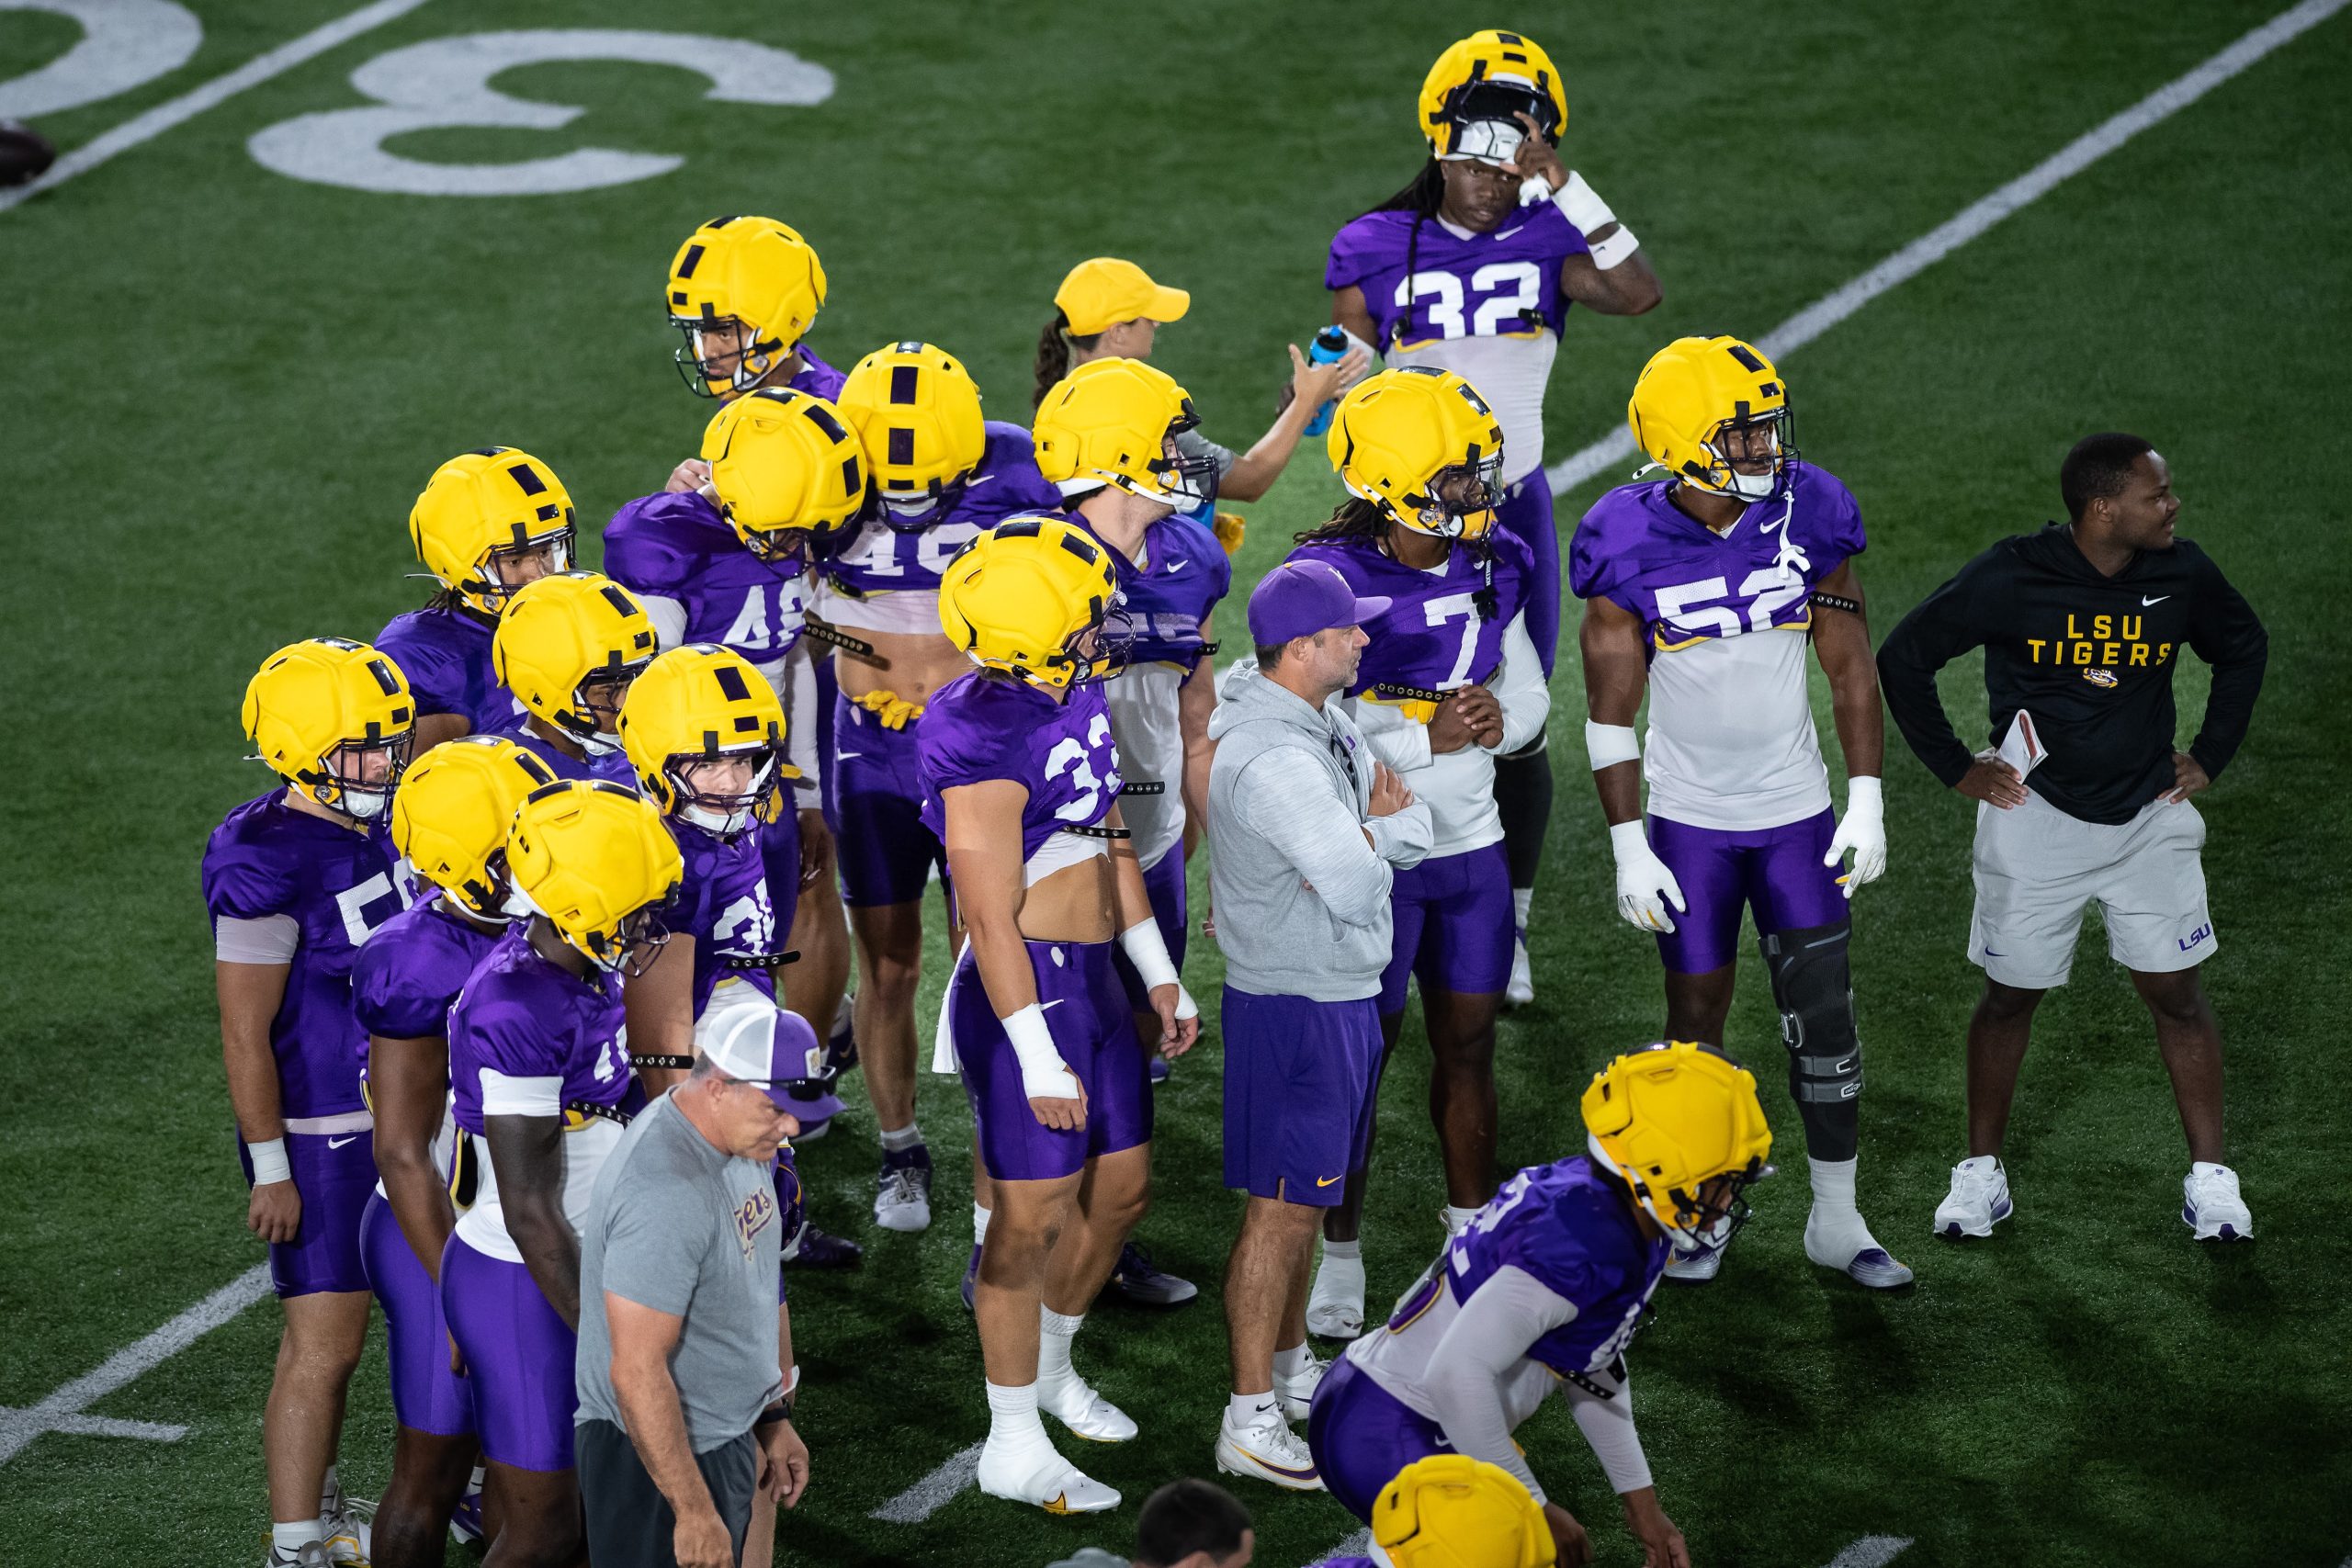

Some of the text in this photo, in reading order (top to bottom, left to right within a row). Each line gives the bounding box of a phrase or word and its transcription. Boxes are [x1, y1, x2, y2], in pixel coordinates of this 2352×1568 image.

[1394, 261, 1542, 340] 32
[1654, 566, 1809, 638] 52
[2067, 614, 2142, 640] LSU
[1423, 592, 1481, 692] 7
[2027, 638, 2171, 667] TIGERS
[2177, 922, 2211, 952] LSU
